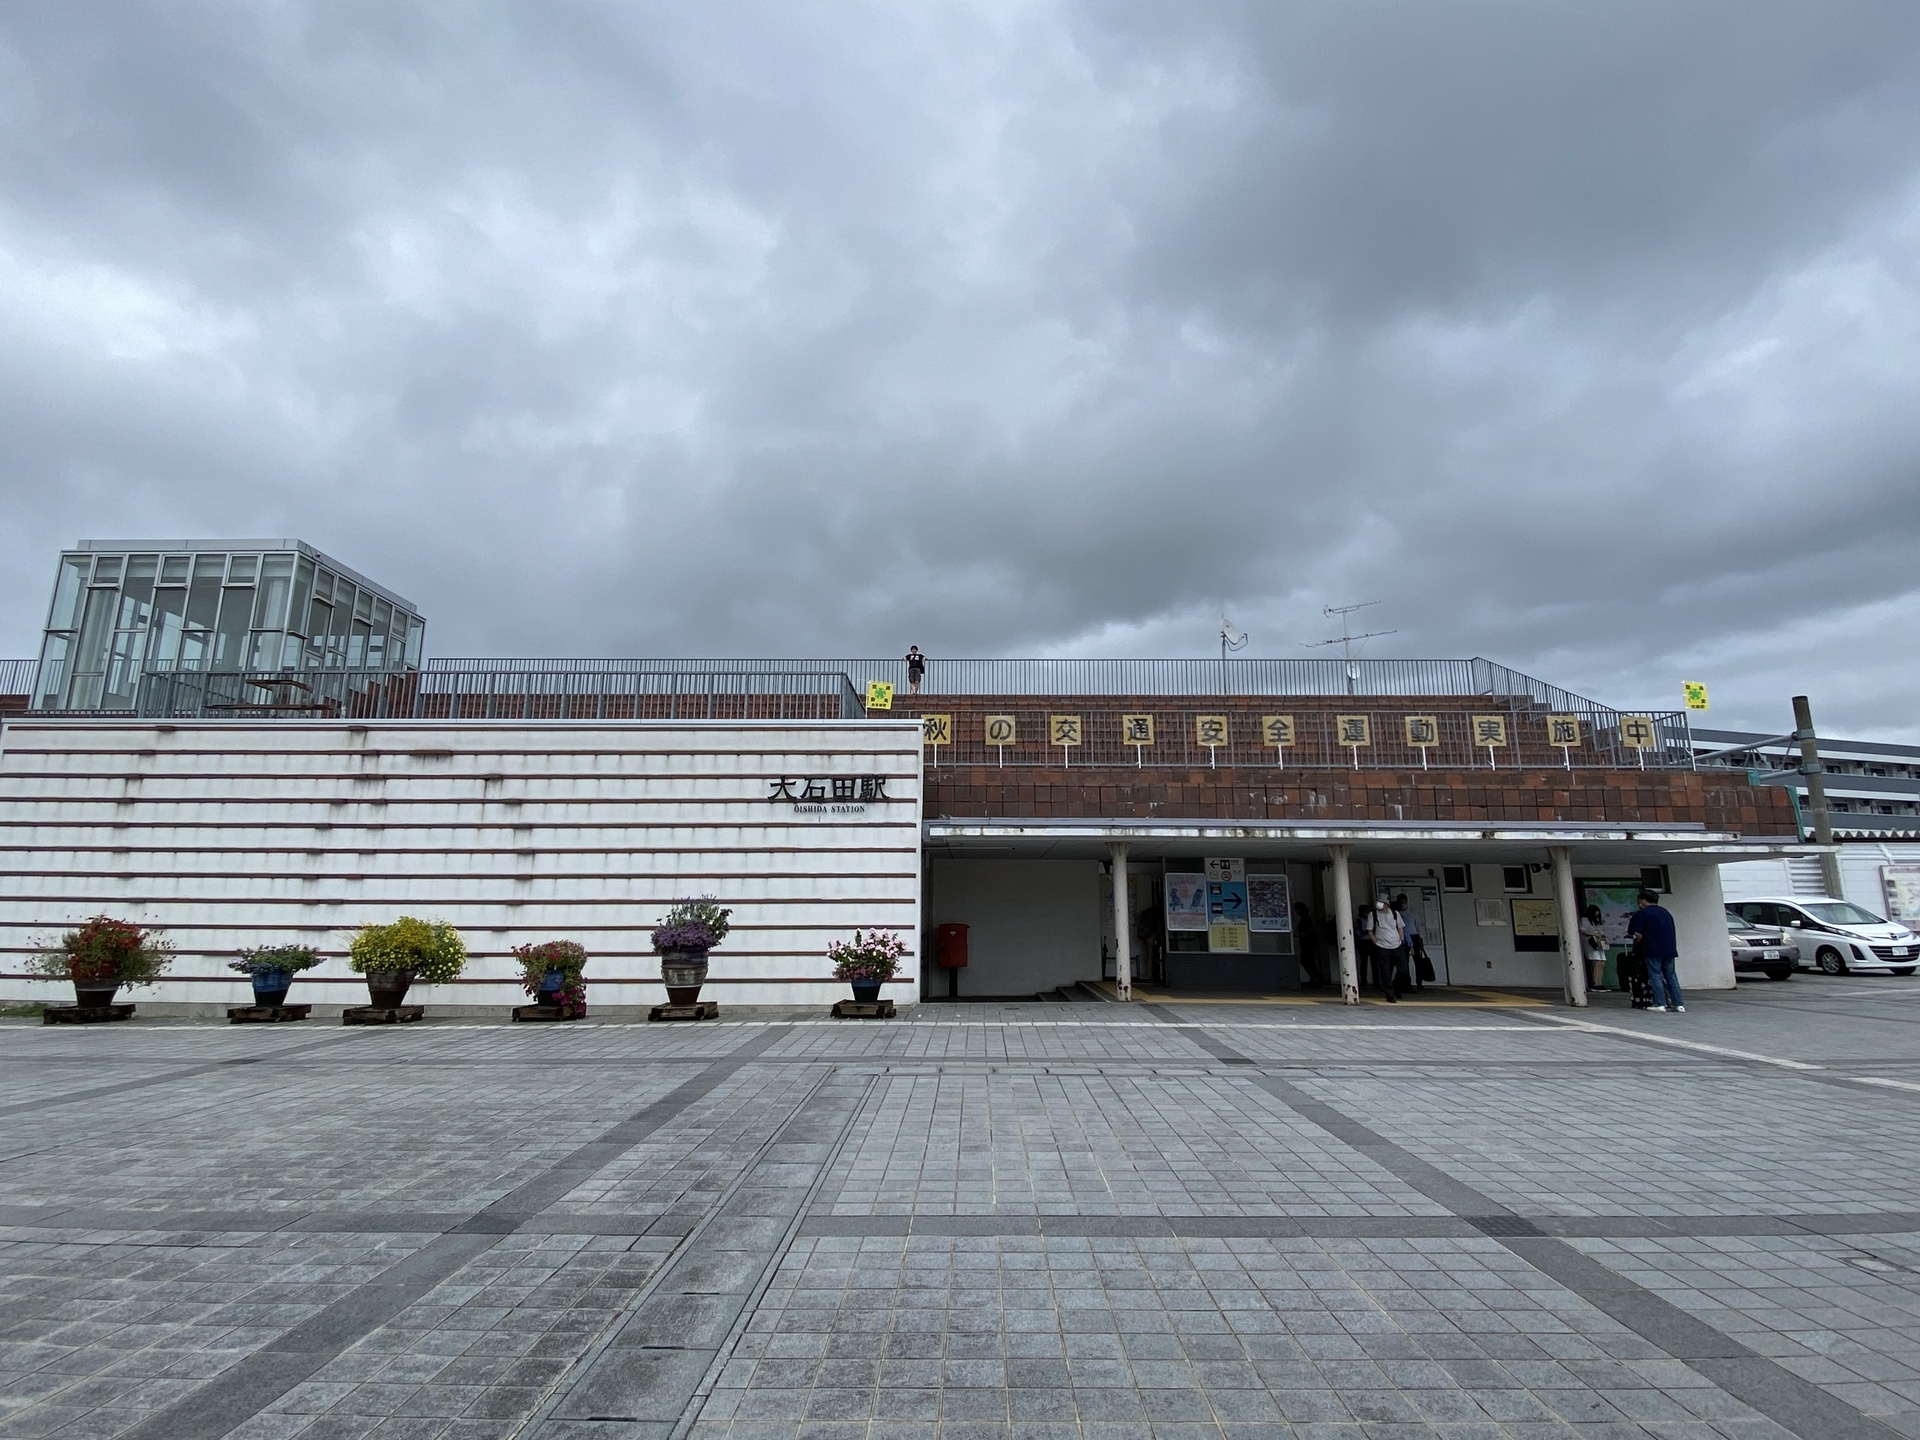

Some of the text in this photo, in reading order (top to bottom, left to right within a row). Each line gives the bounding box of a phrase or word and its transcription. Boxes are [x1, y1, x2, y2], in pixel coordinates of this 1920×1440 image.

[767, 774, 890, 803] 大石田駅
[831, 805, 865, 813] STATION
